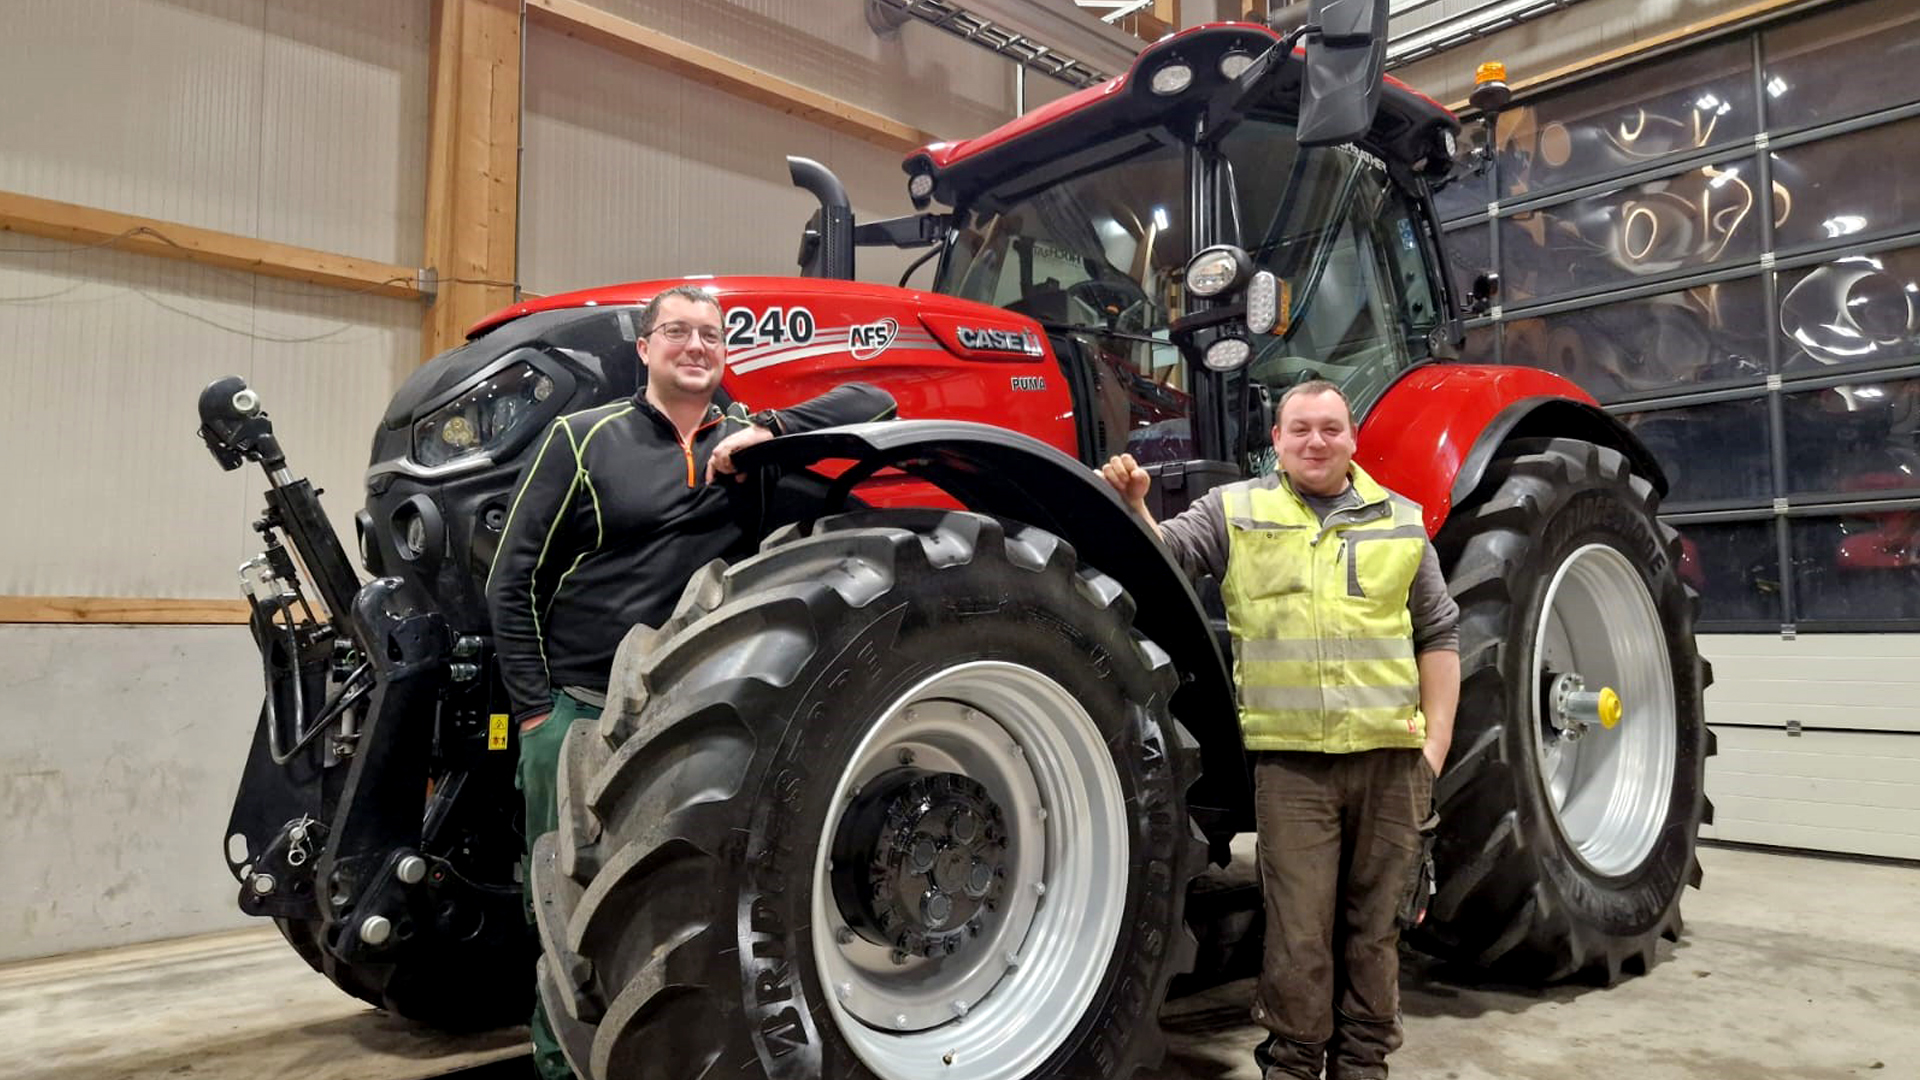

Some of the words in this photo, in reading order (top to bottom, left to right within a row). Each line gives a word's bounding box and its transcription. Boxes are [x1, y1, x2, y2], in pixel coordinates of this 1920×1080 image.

[726, 307, 815, 347] 240
[850, 322, 889, 348] AFS
[956, 326, 1021, 350] CASE
[1011, 376, 1046, 391] PUMA
[1548, 496, 1667, 577] IDGESTONE
[751, 640, 883, 1060] BRIDSTONE
[1090, 736, 1172, 1079] BRGSTONE
